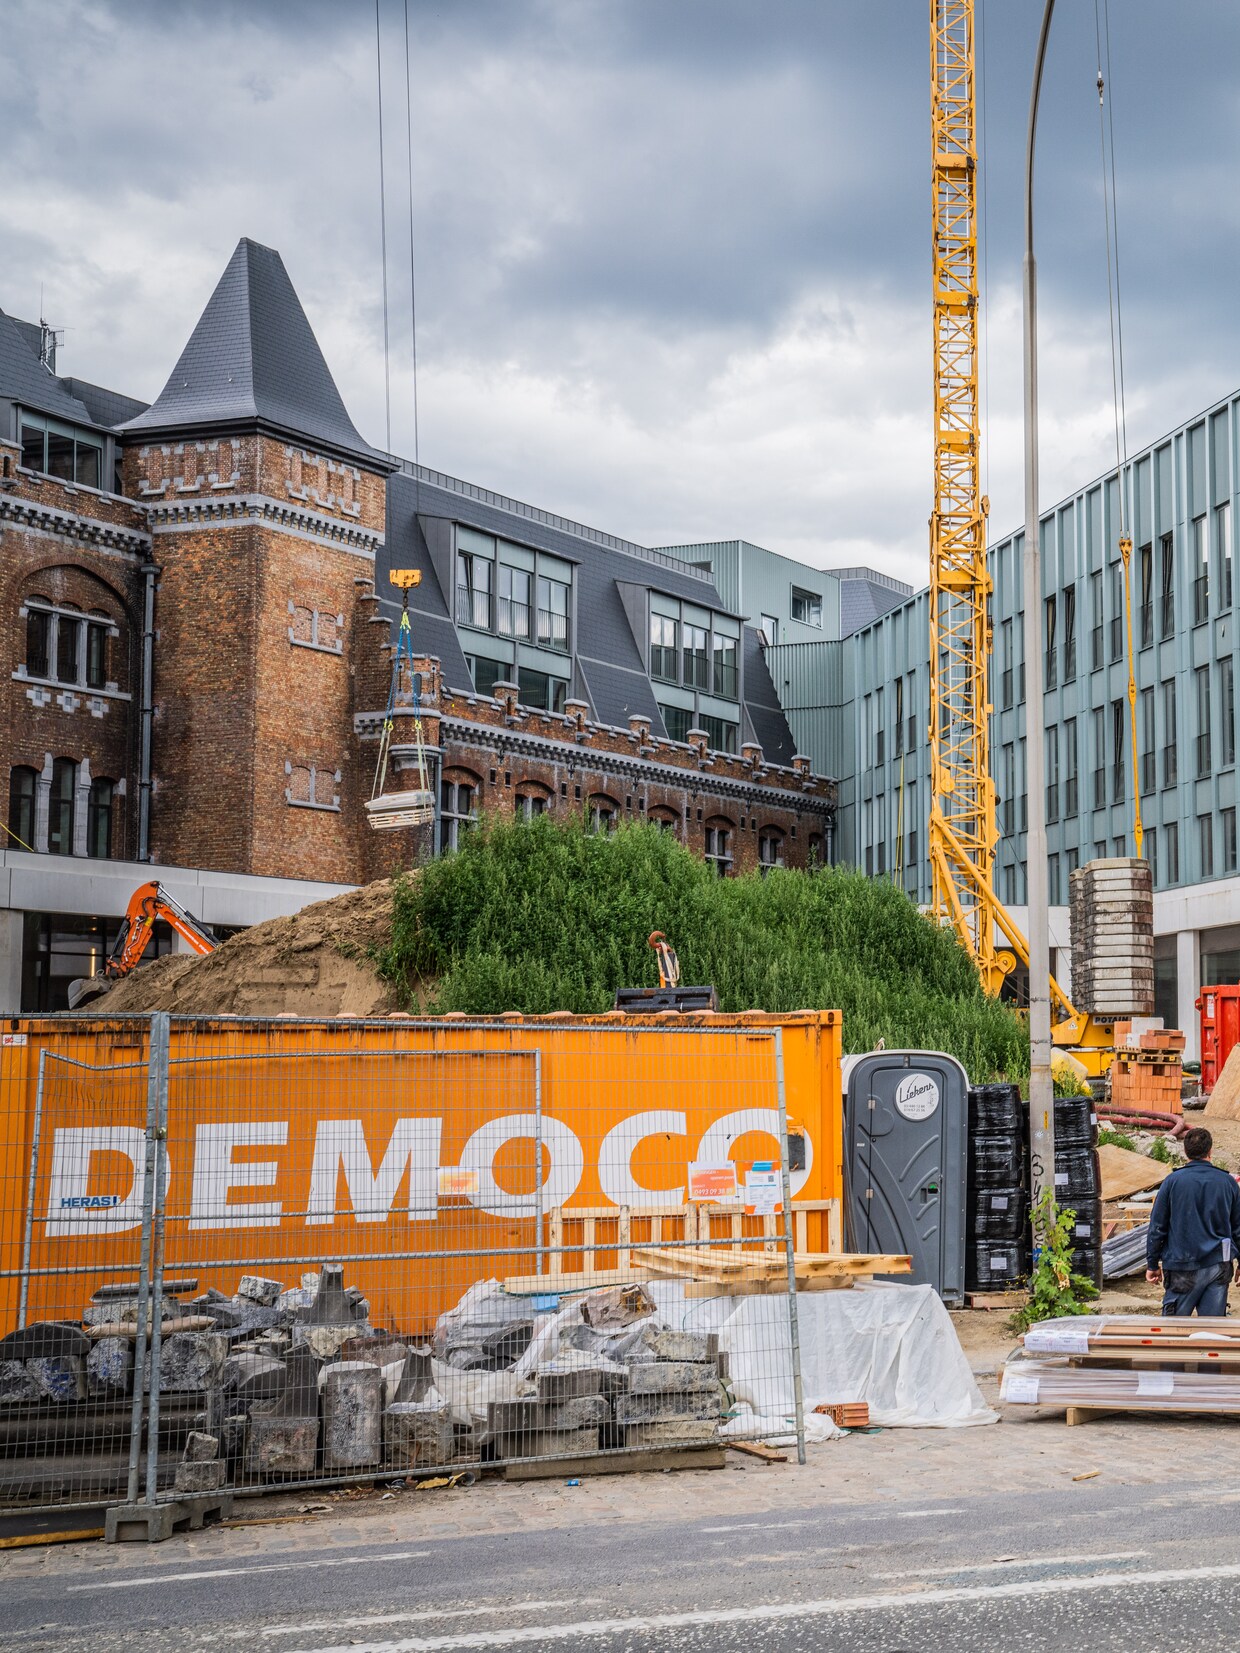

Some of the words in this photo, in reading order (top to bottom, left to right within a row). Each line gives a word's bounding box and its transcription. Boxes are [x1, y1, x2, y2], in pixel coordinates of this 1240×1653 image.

[1095, 1016, 1129, 1024] POTAIN
[900, 1075, 934, 1103] Liekens
[45, 1108, 814, 1238] DEMOCO
[61, 1196, 112, 1208] HERAS
